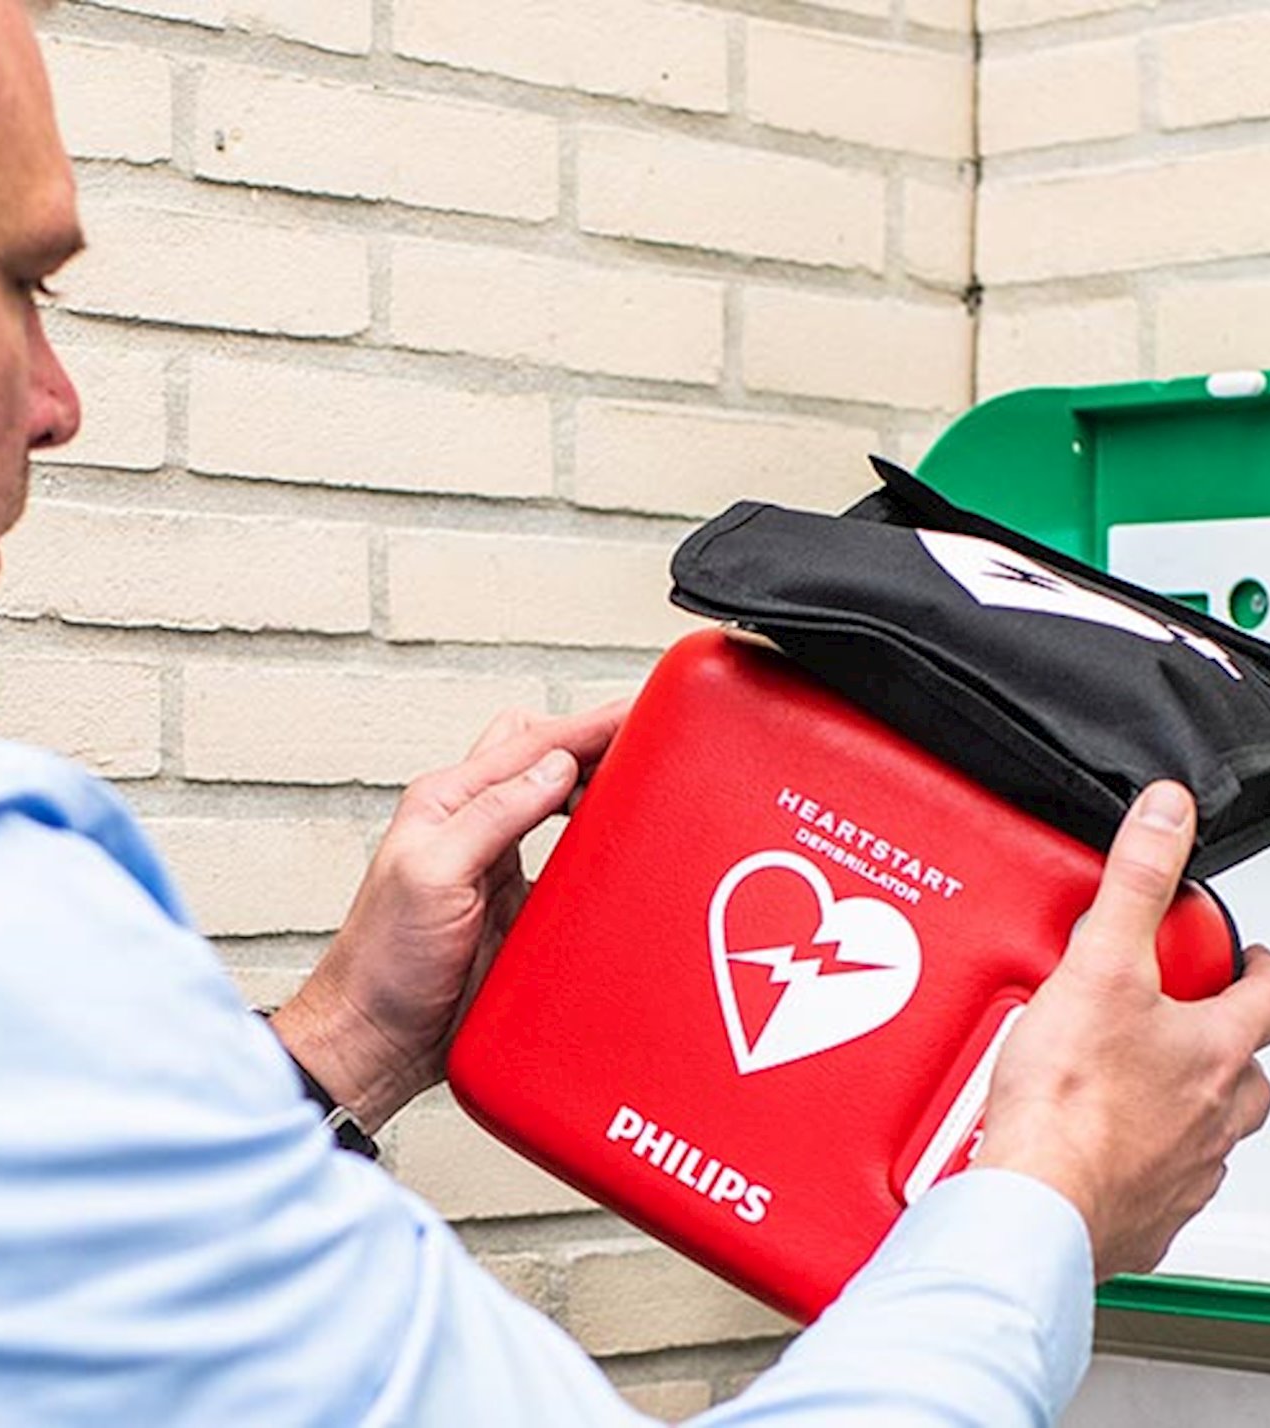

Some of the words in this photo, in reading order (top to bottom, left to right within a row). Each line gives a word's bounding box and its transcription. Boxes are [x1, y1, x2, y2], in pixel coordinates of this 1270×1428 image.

[777, 787, 963, 898] HEARTSTART
[795, 827, 922, 905] DEFIBRILLATOR
[606, 1106, 772, 1223] PHILIPS
